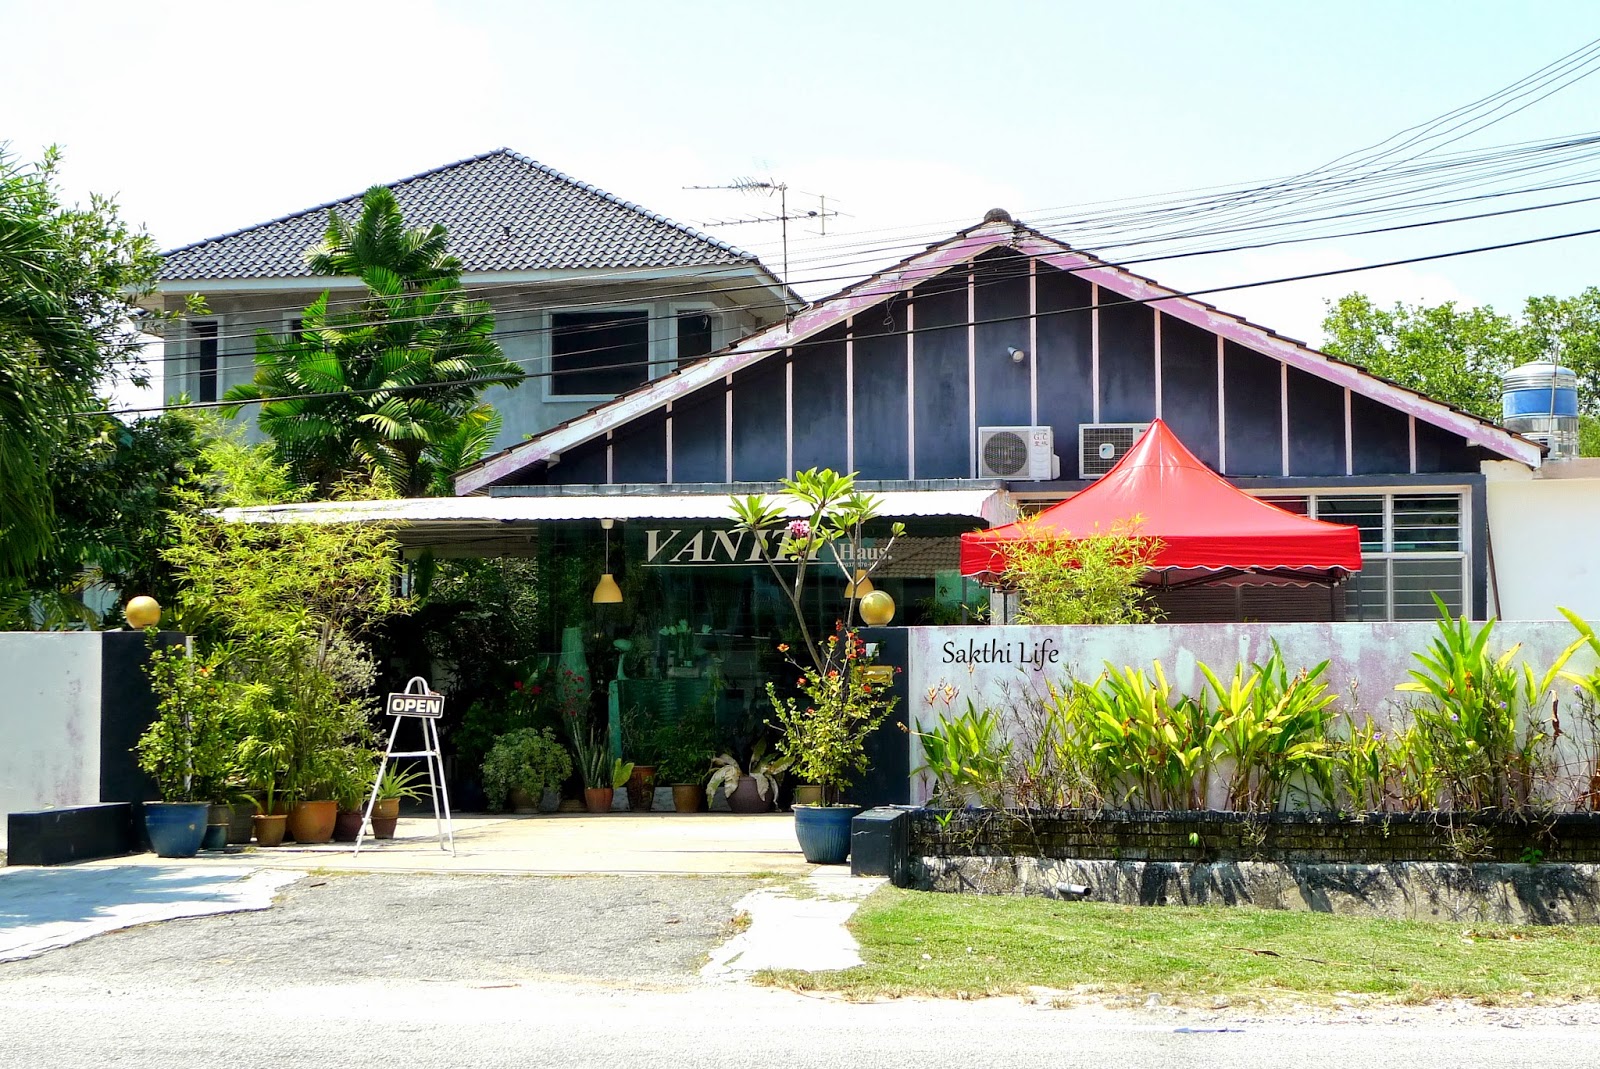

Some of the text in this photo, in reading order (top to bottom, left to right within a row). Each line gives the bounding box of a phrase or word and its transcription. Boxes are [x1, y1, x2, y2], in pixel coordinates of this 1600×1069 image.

[839, 543, 893, 560] Haus.
[942, 638, 1059, 672] Sakthi Life
[392, 698, 441, 713] OPEN
